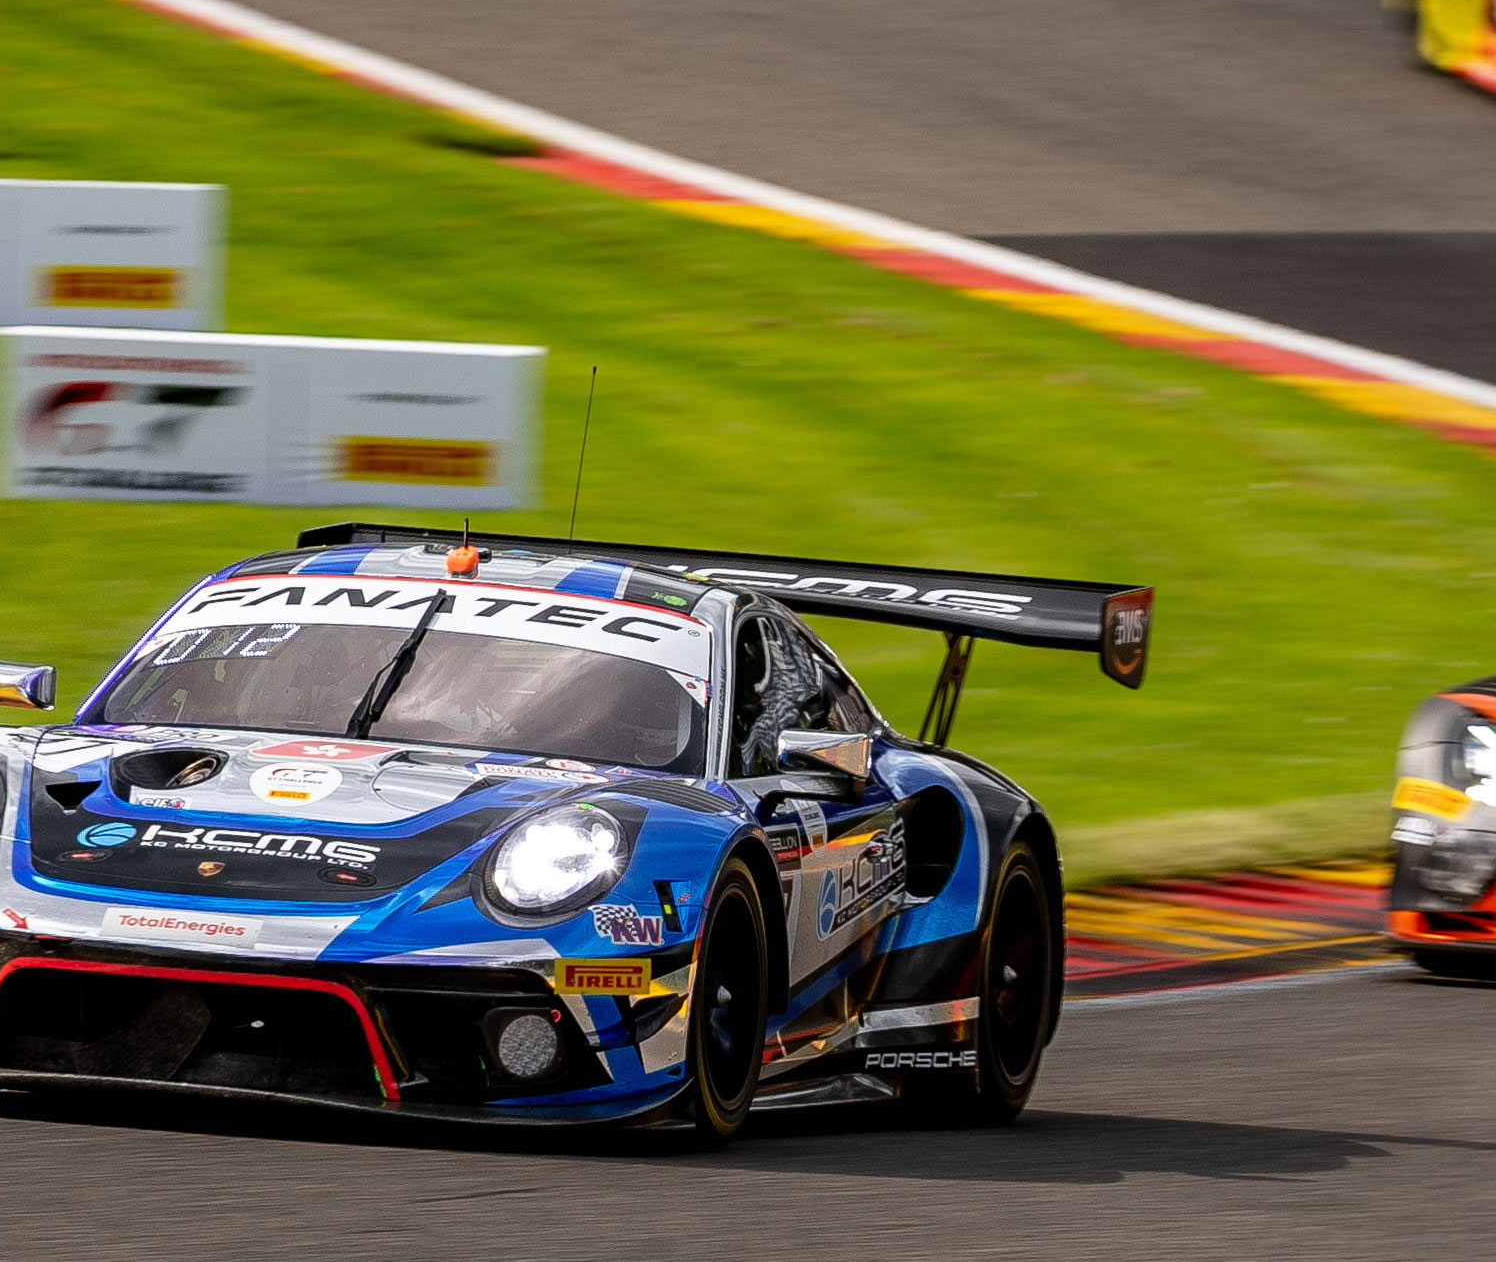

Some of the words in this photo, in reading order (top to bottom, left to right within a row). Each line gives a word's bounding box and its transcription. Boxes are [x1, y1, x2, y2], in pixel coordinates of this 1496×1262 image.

[667, 564, 1033, 622] CMG
[187, 586, 684, 643] FANATEC
[140, 824, 382, 863] KCMG
[174, 842, 323, 861] MOTORGROUP
[119, 914, 246, 936] TotalEnergies
[565, 965, 643, 988] PIRELLI
[865, 1050, 977, 1069] PORSCHE
